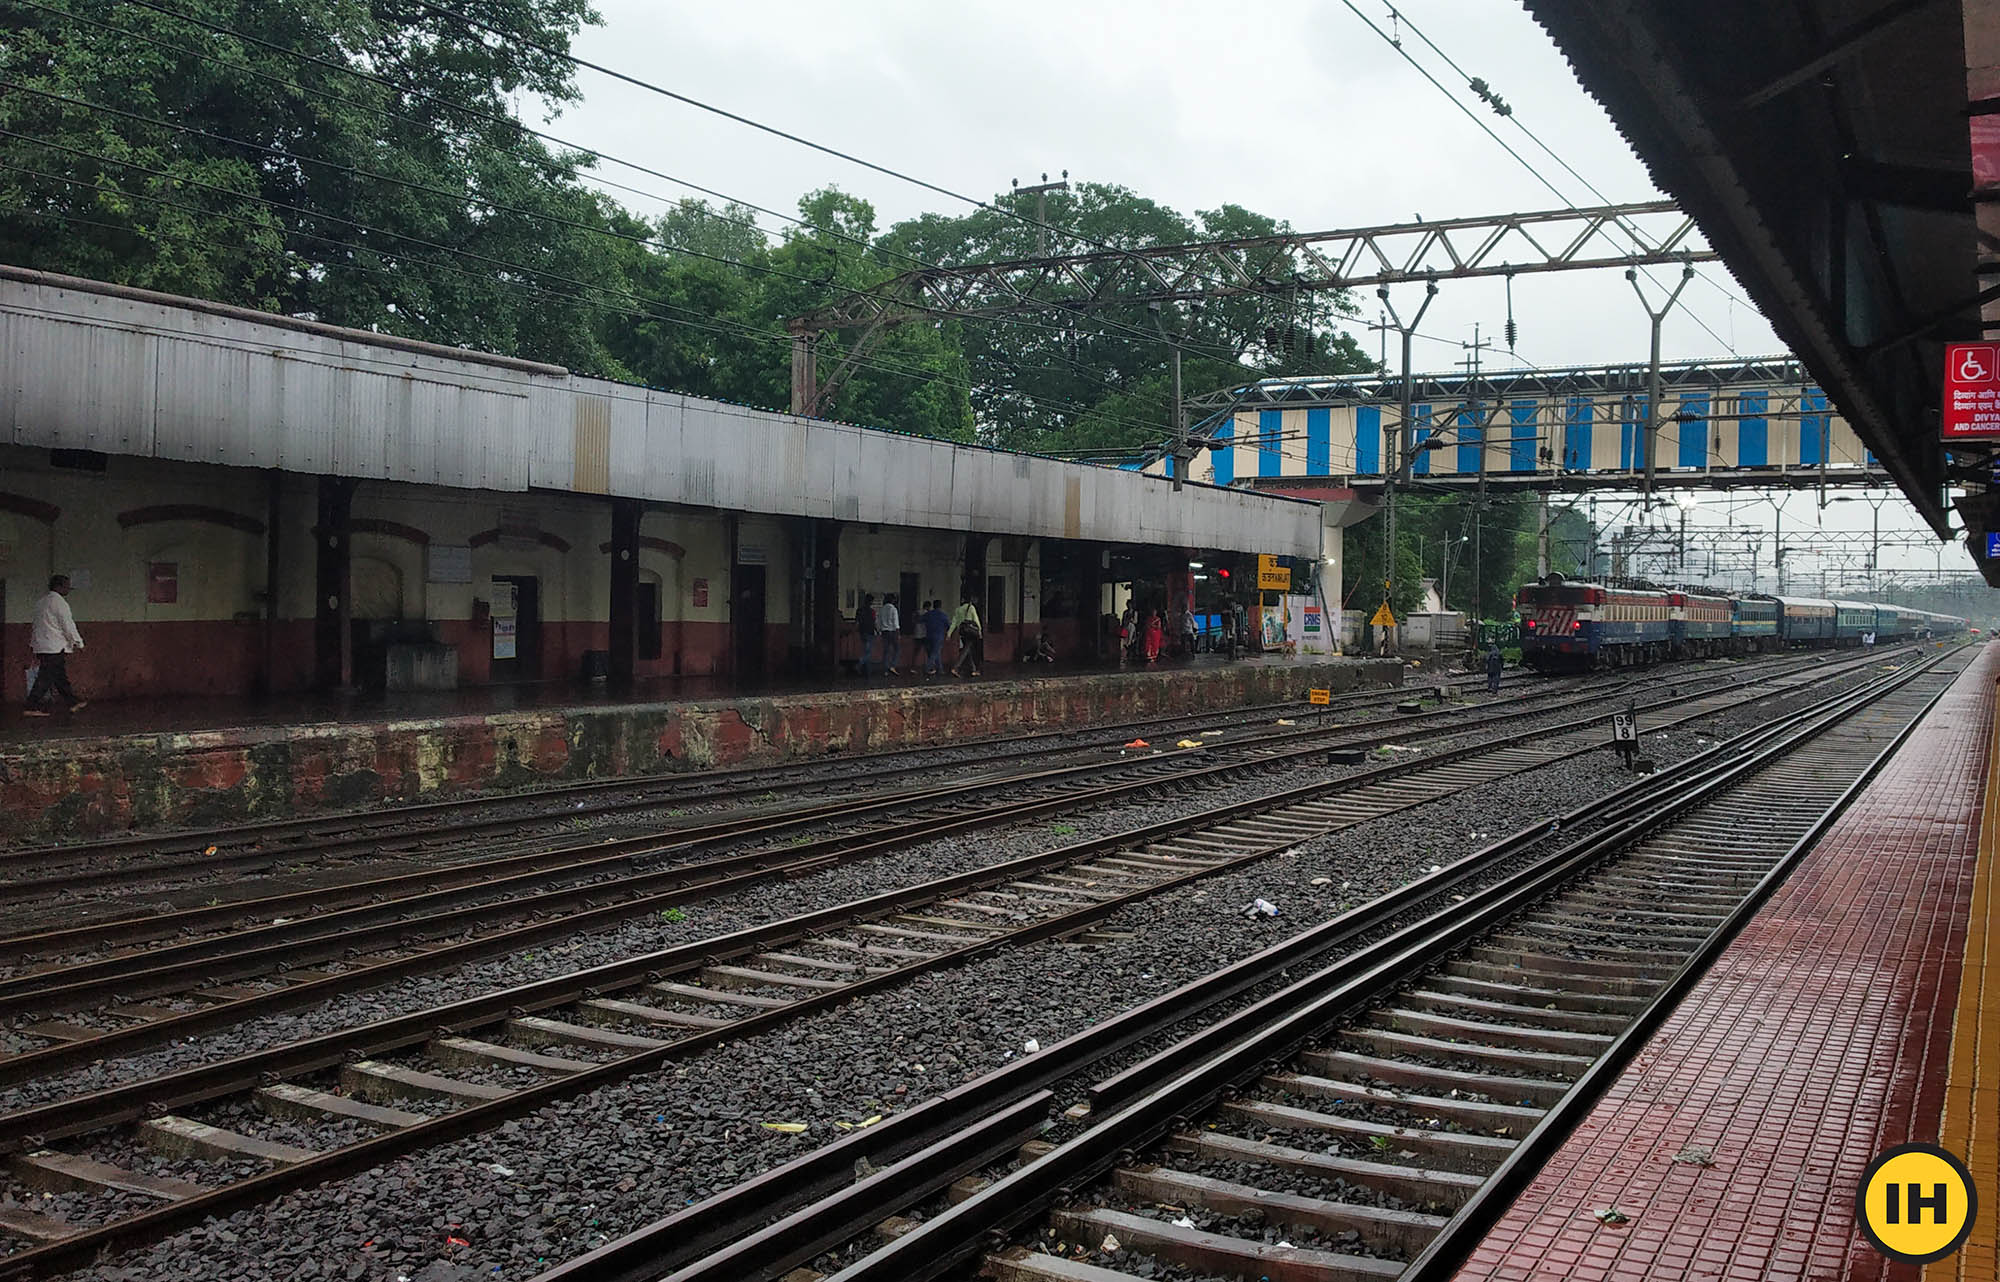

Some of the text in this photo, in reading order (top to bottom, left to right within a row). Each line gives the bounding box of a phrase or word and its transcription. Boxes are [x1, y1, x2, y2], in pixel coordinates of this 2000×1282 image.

[1954, 423, 1970, 431] AND
[1615, 715, 1633, 726] 99
[1621, 727, 1630, 739] 8
